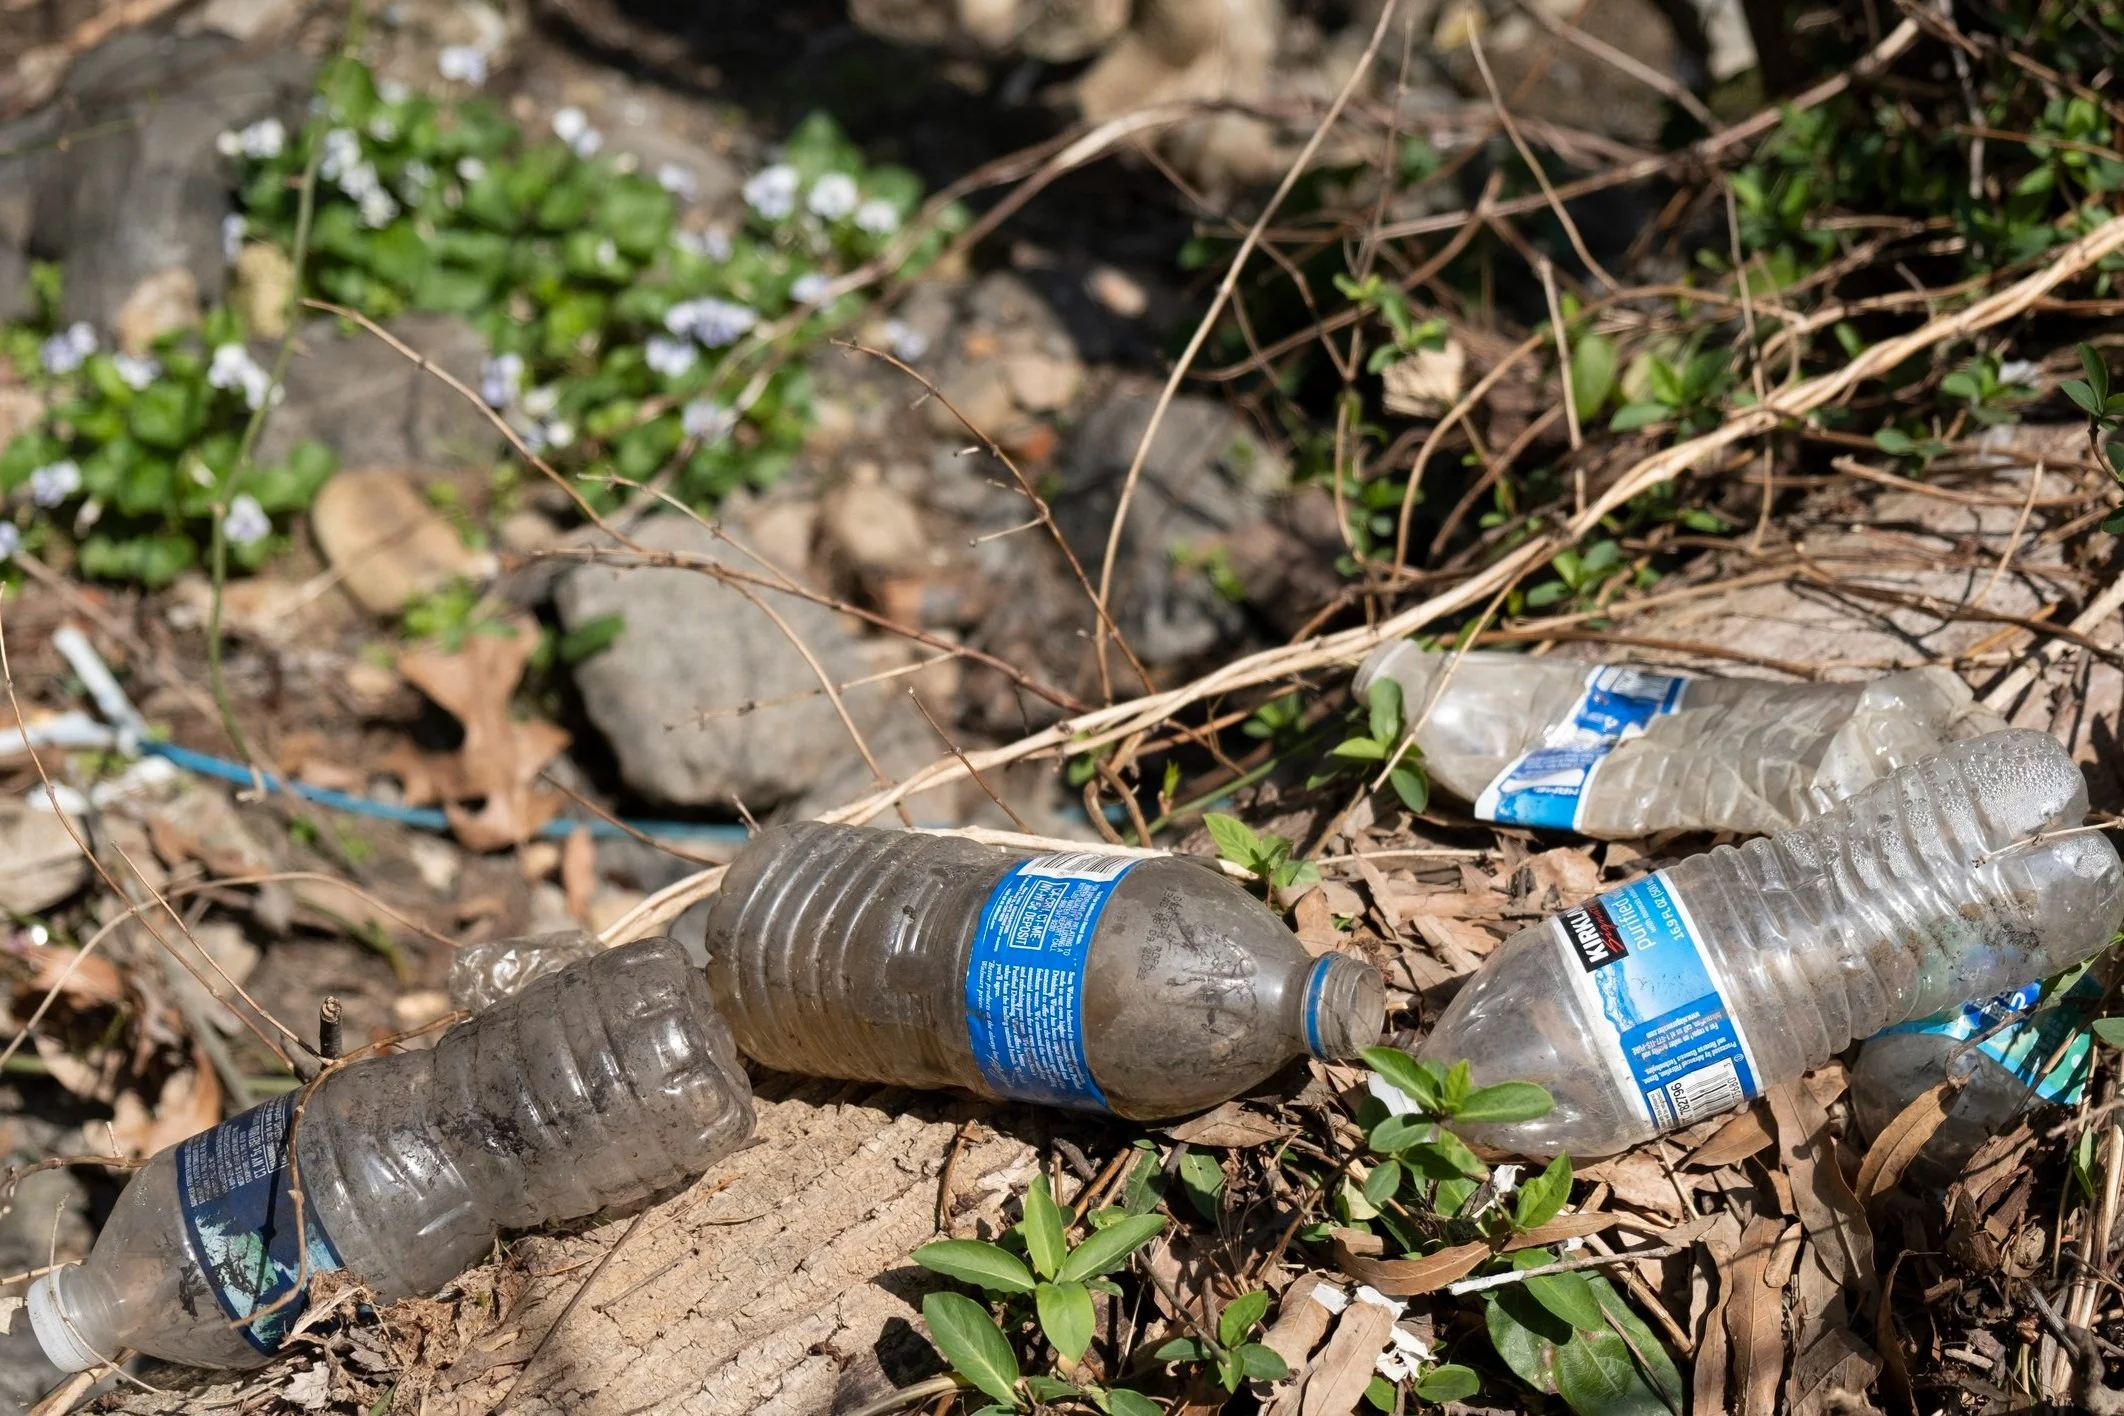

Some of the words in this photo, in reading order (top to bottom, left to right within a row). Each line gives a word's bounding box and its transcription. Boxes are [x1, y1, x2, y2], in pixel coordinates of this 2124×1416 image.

[1032, 882, 1053, 900] NY-HI
[1038, 887, 1062, 912] CA-CRV,
[1645, 883, 1664, 899] (500
[1061, 899, 1074, 915] WATER
[1068, 897, 1083, 917] QUALITY
[1633, 897, 1649, 919] minerals
[1653, 895, 1668, 909] OZ
[1659, 906, 1673, 920] FL
[1015, 911, 1036, 945] DEPOSIT
[1028, 913, 1048, 941] CT-ME-
[1053, 915, 1067, 936] REPORT
[1057, 918, 1074, 947] INCLUDING
[1563, 903, 1609, 963] KIRKLA
[1610, 897, 1656, 951] purified
[1643, 917, 1656, 933] with
[1665, 917, 1684, 941] 16.9
[1064, 920, 1079, 947] RELATING
[1048, 938, 1059, 952] CALL
[1062, 948, 1071, 956] TO
[978, 960, 988, 988] Walmart
[1011, 965, 1019, 988] Purified
[1026, 966, 1034, 991] essential
[1034, 967, 1043, 990] freshest
[1046, 969, 1059, 997] Drinking
[1067, 971, 1075, 984] Sam
[1015, 978, 1023, 1007] refreshing
[1066, 985, 1074, 1008] Walton
[1008, 989, 1017, 1016] Drinking
[1041, 1003, 1049, 1017] offer
[1049, 998, 1057, 1015] Water
[1034, 1010, 1040, 1020] We
[1066, 1009, 1074, 1032] believed
[1034, 1021, 1045, 1046] enhanced
[1056, 1020, 1065, 1038] higher
[1682, 1023, 1693, 1033] call
[1689, 1027, 1705, 1040] report
[1708, 1021, 1719, 1030] For
[1003, 1026, 1013, 1047] national
[1667, 1037, 1683, 1049] water
[1715, 1036, 1726, 1045] and
[1640, 1050, 1651, 1060] and
[1650, 1042, 1668, 1056] quality
[1676, 1048, 1697, 1062] Osmosis
[1696, 1040, 1717, 1053] Reverse
[1703, 1050, 1711, 1058] by
[1710, 1040, 1737, 1056] Processed
[1643, 1057, 1677, 1075] Technologies.
[1680, 1053, 1705, 1068] Advanced
[250, 1154, 264, 1167] NY
